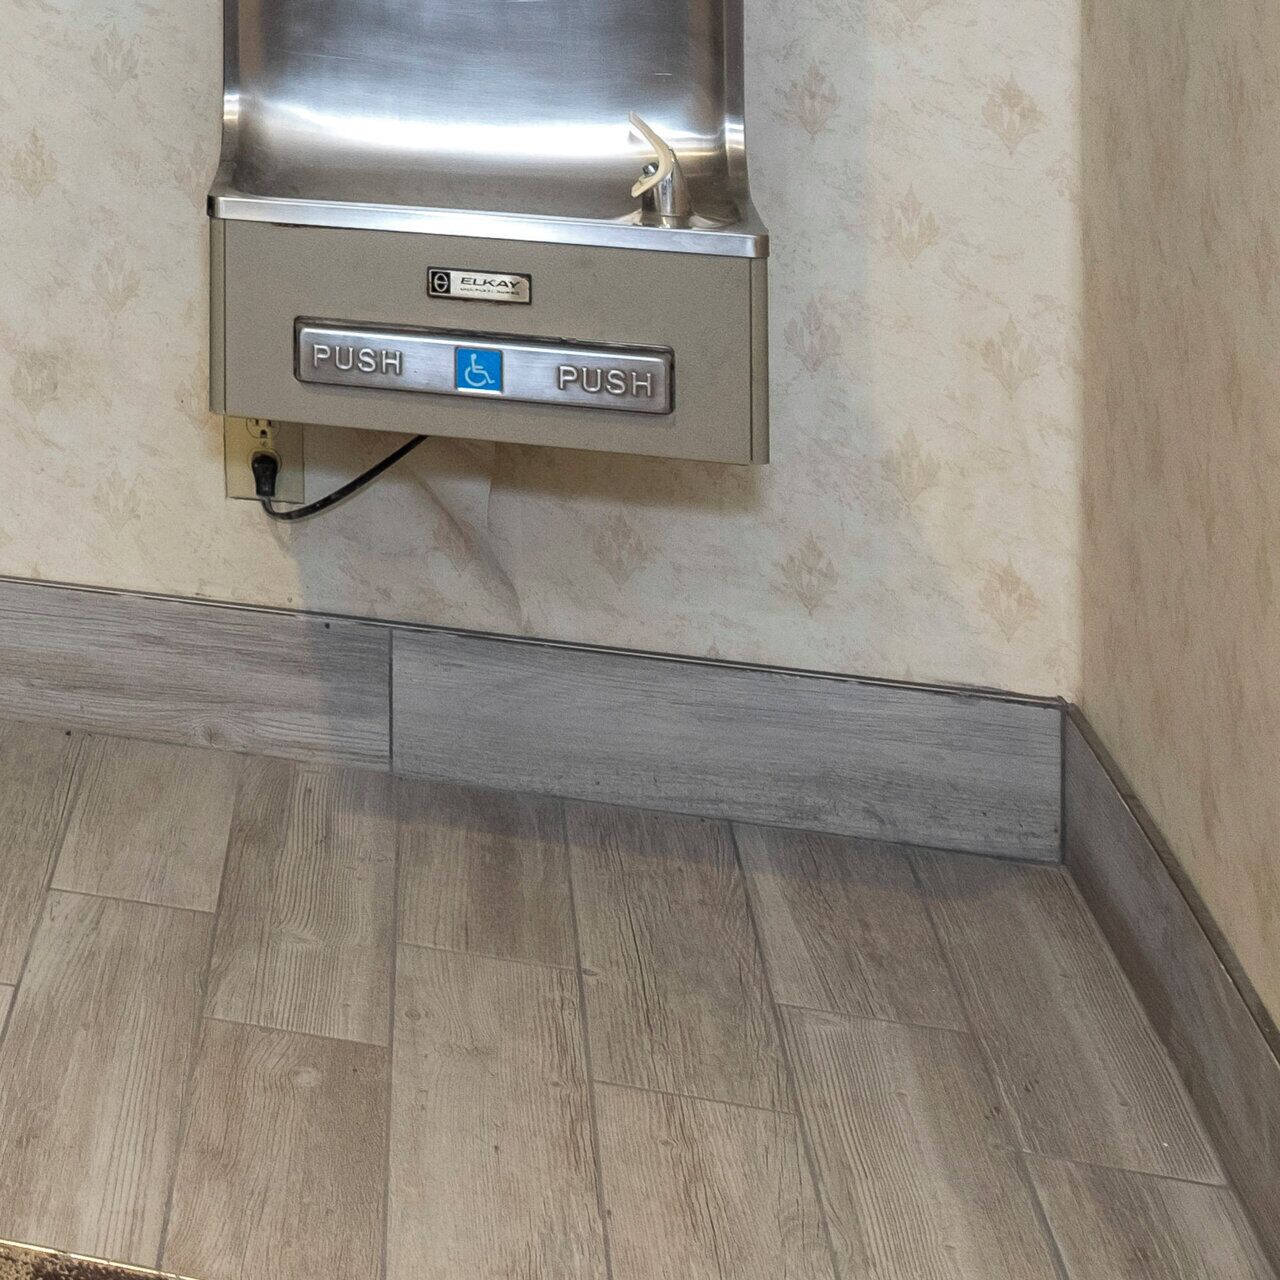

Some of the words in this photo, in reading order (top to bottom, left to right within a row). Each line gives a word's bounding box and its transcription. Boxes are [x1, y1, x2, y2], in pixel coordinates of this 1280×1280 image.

[460, 277, 521, 289] ELKAY
[312, 344, 403, 376] PUSH
[557, 366, 653, 398] PUSH
